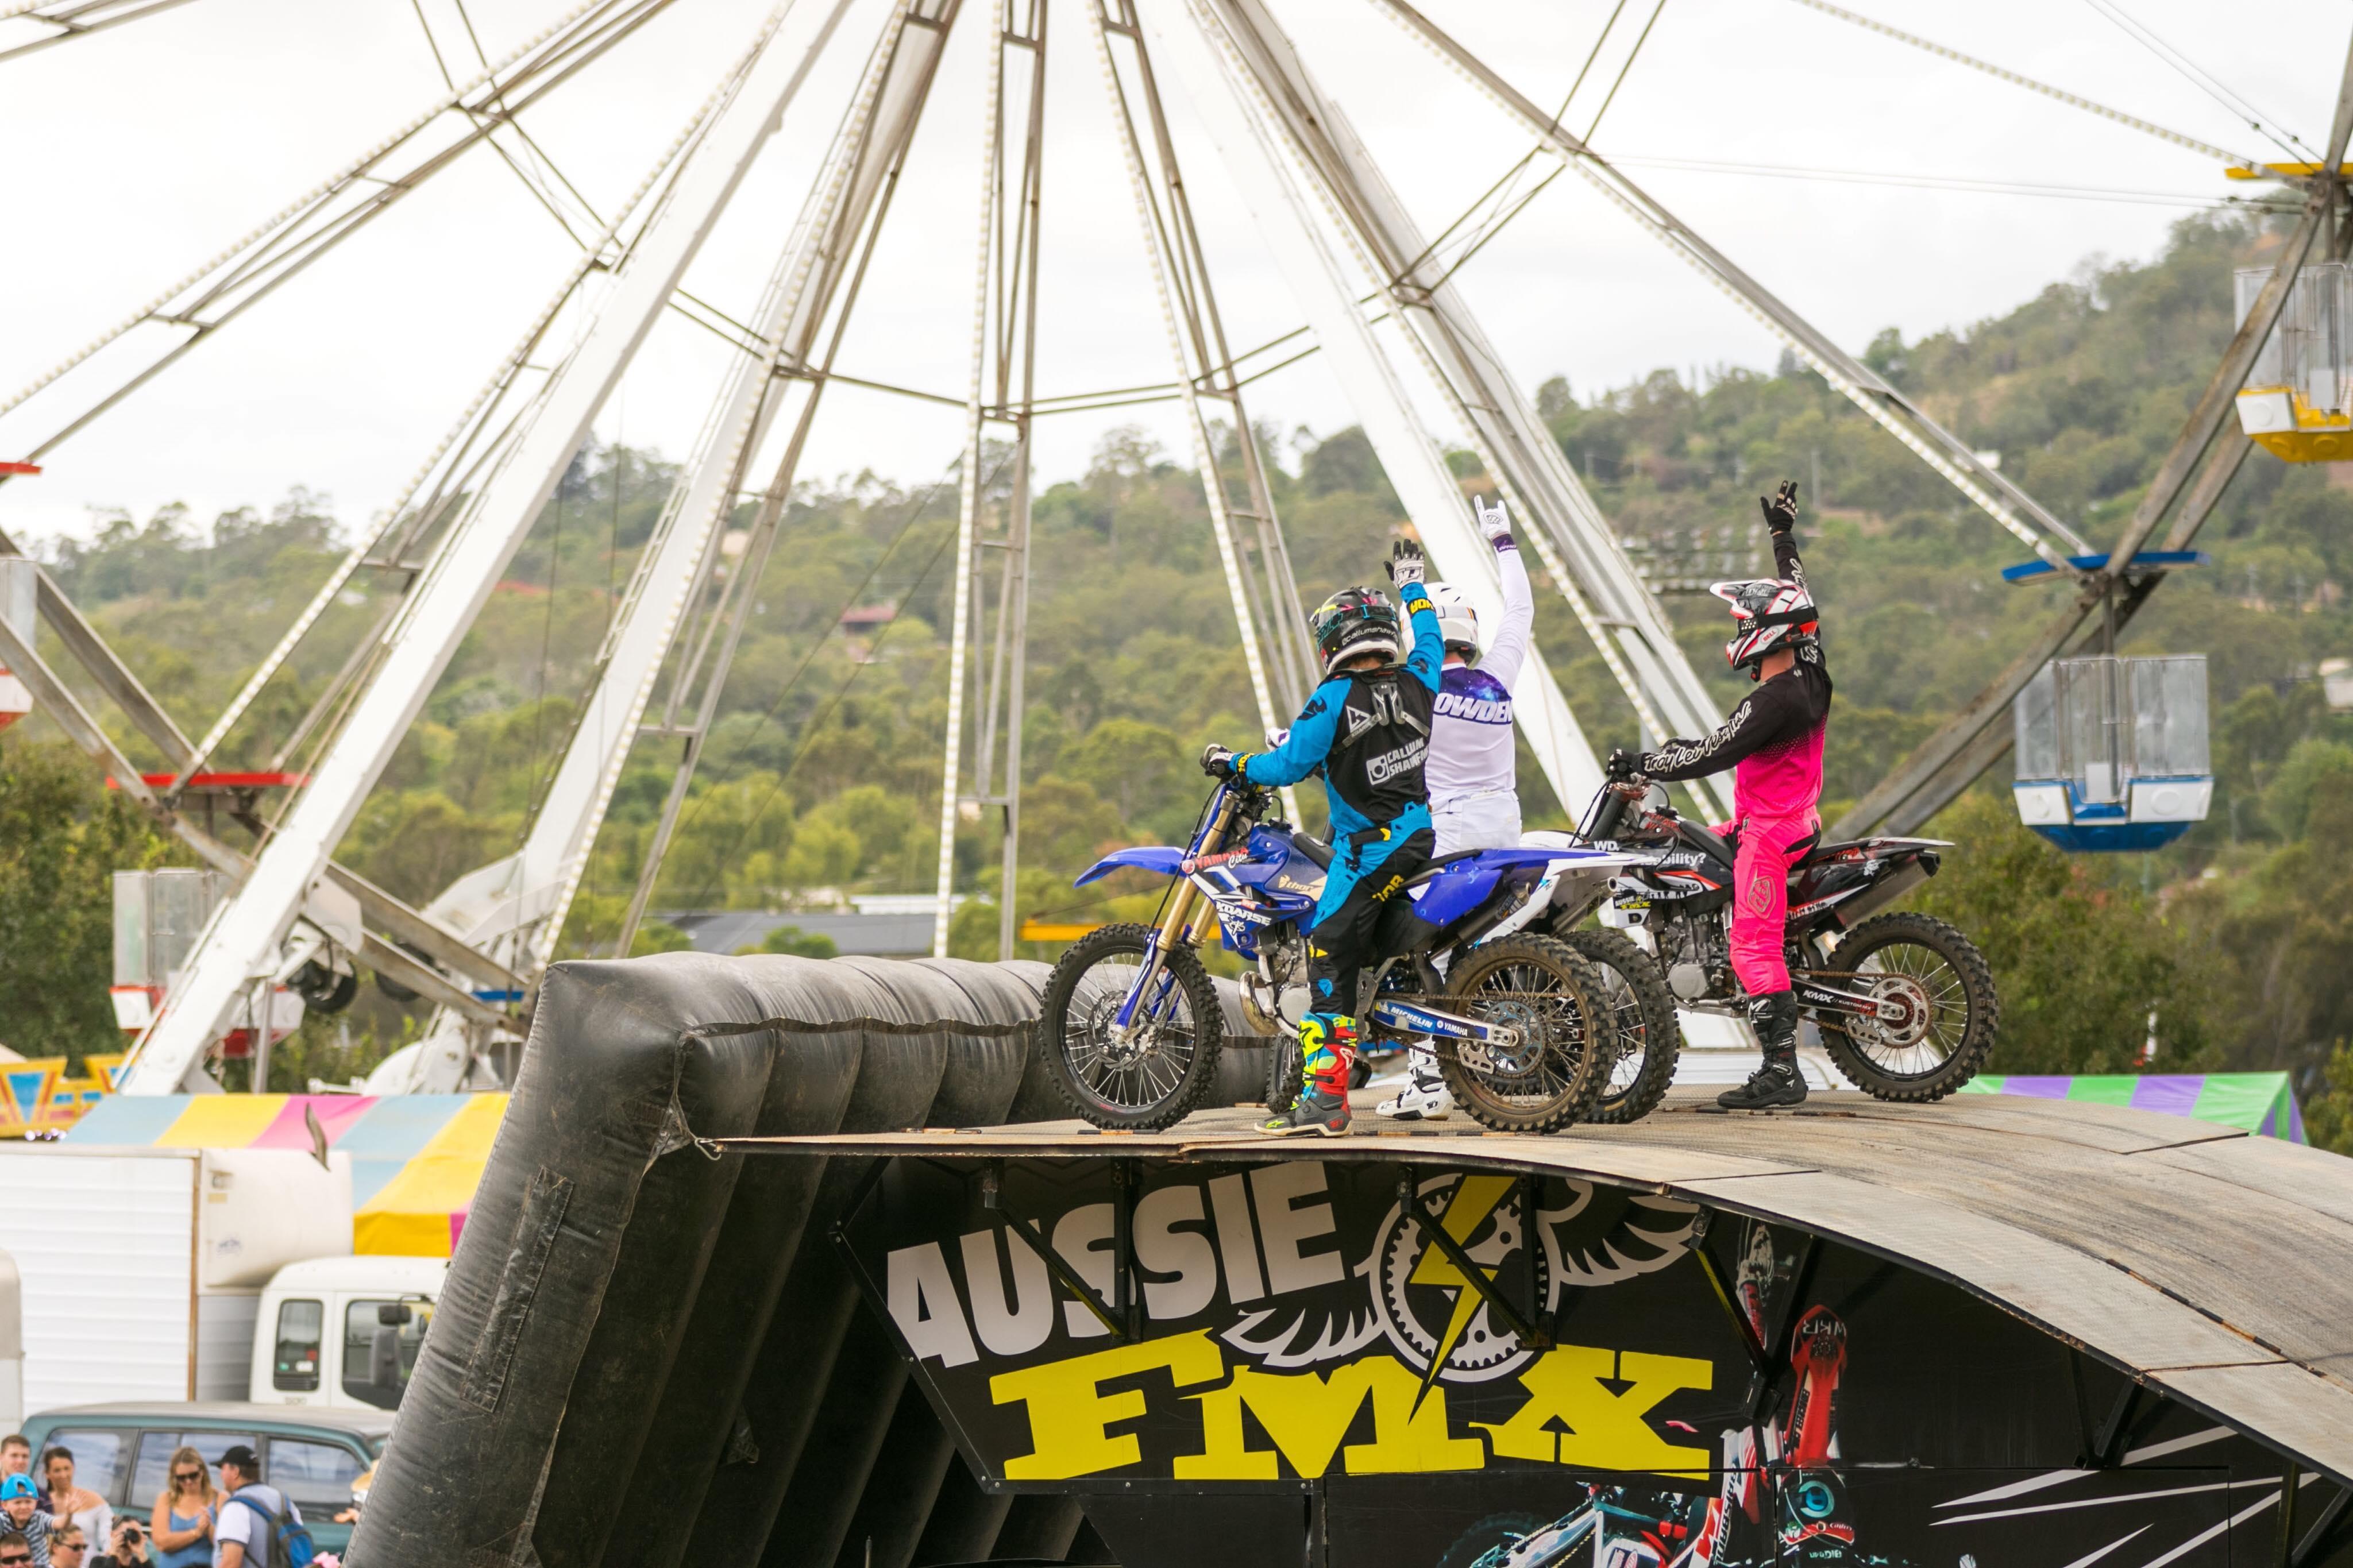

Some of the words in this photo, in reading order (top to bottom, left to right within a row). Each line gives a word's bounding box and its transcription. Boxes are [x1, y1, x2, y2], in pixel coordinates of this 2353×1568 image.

[1763, 630, 1776, 642] BELL
[1433, 693, 1513, 724] OWDEN
[1386, 737, 1425, 764] CALLUM
[1388, 745, 1429, 777] SHAWFM
[1803, 990, 1834, 1003] KMX
[1391, 1006, 1433, 1029] MICHELIN
[1444, 1022, 1468, 1037] YAMAHA
[888, 1161, 1345, 1368] AUSSIE
[989, 1327, 1713, 1481] FMX
